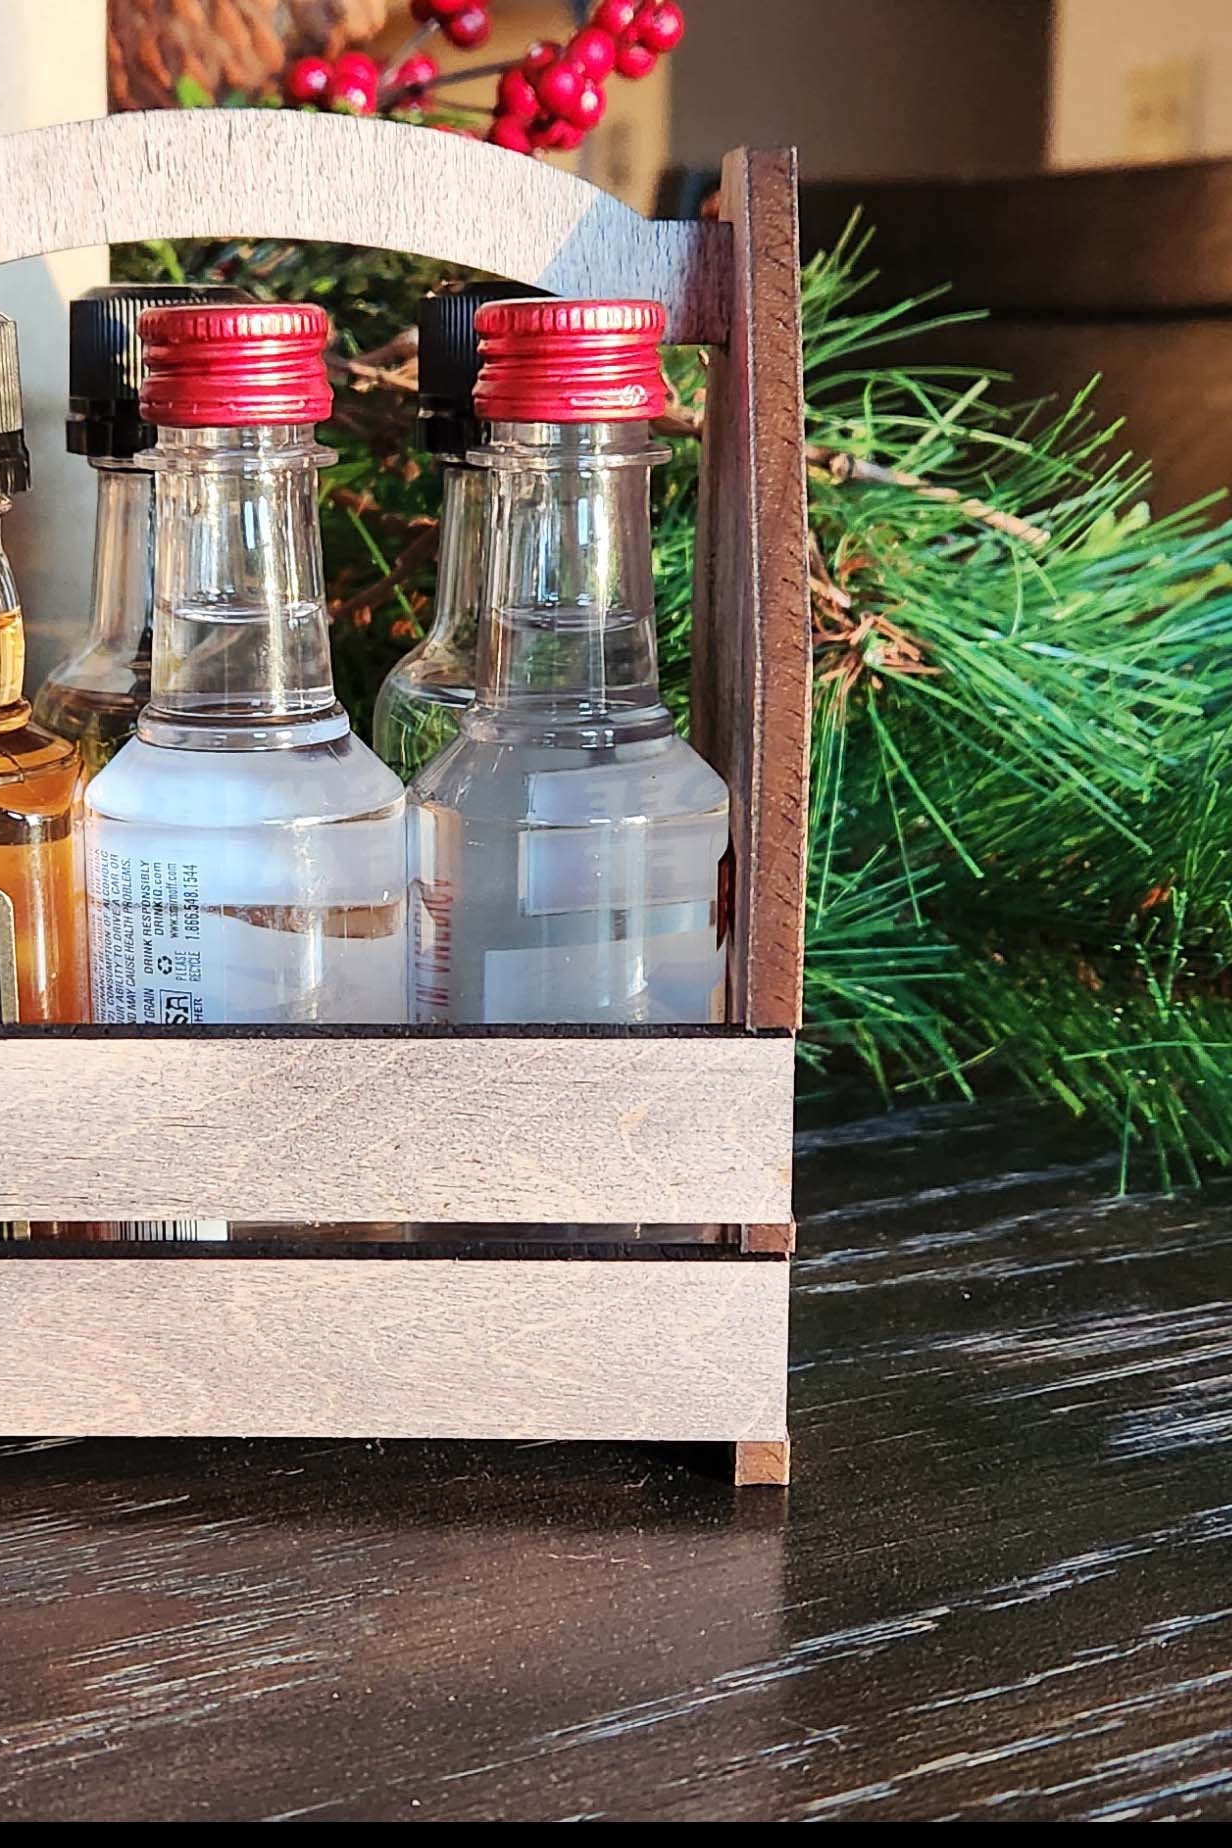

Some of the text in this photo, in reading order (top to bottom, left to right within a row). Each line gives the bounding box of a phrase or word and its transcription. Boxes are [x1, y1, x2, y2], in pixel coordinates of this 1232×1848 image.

[110, 854, 119, 870] OR
[111, 873, 120, 894] CAR
[121, 857, 133, 914] PROBLEMS.
[112, 899, 120, 908] A
[140, 860, 154, 974] DRINK RESPONSIBLY
[182, 864, 200, 940] 1.866.548.1544
[103, 912, 111, 927] OF
[112, 910, 122, 941] DRIVE
[123, 916, 134, 953] HEALTH
[113, 945, 122, 959] TO
[174, 951, 187, 981] PLEASE
[188, 952, 201, 982] RECYCLE
[104, 931, 114, 1005] CONSUMPTION
[114, 962, 124, 1003] ABILITY
[124, 954, 135, 987] CAUSE
[126, 989, 136, 1011] MAY
[143, 988, 155, 1018] GRAIN
